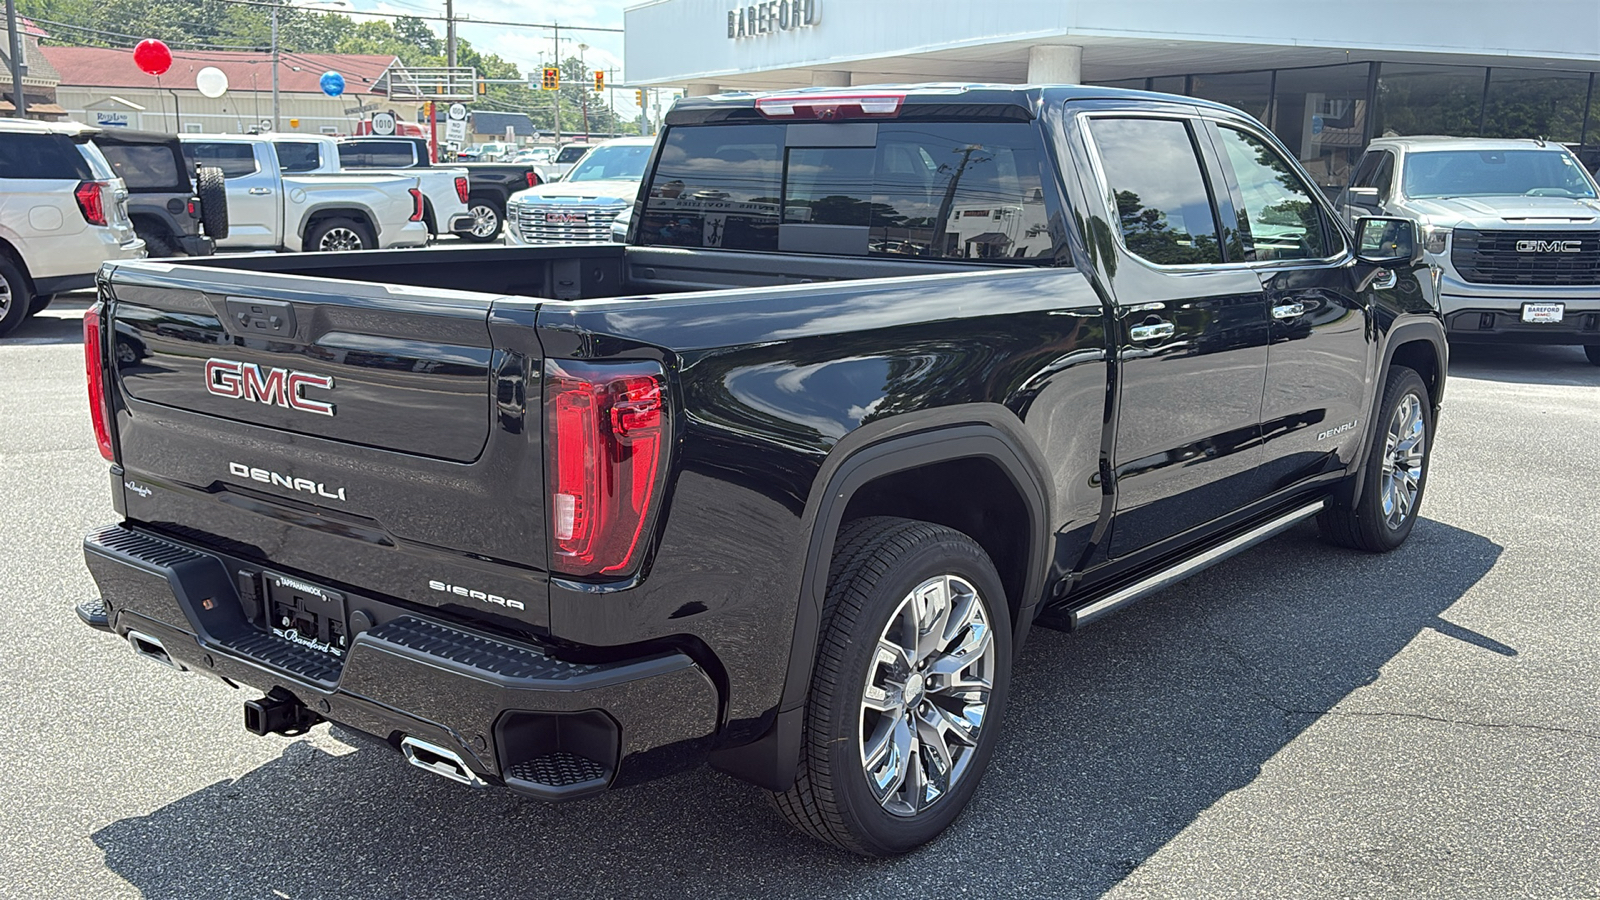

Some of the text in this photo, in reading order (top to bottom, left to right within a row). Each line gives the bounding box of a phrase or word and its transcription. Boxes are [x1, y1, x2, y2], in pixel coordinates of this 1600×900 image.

[727, 0, 819, 39] BAREFORD
[375, 119, 392, 129] 1010
[546, 213, 586, 223] GMC
[1516, 240, 1582, 253] GMC
[204, 357, 337, 417] GMC
[1317, 419, 1358, 441] DENALI
[229, 461, 347, 501] DENALI
[280, 577, 322, 597] TAPPAHANNOCK
[428, 580, 526, 611] SIERRA
[284, 628, 331, 653] Bareford
